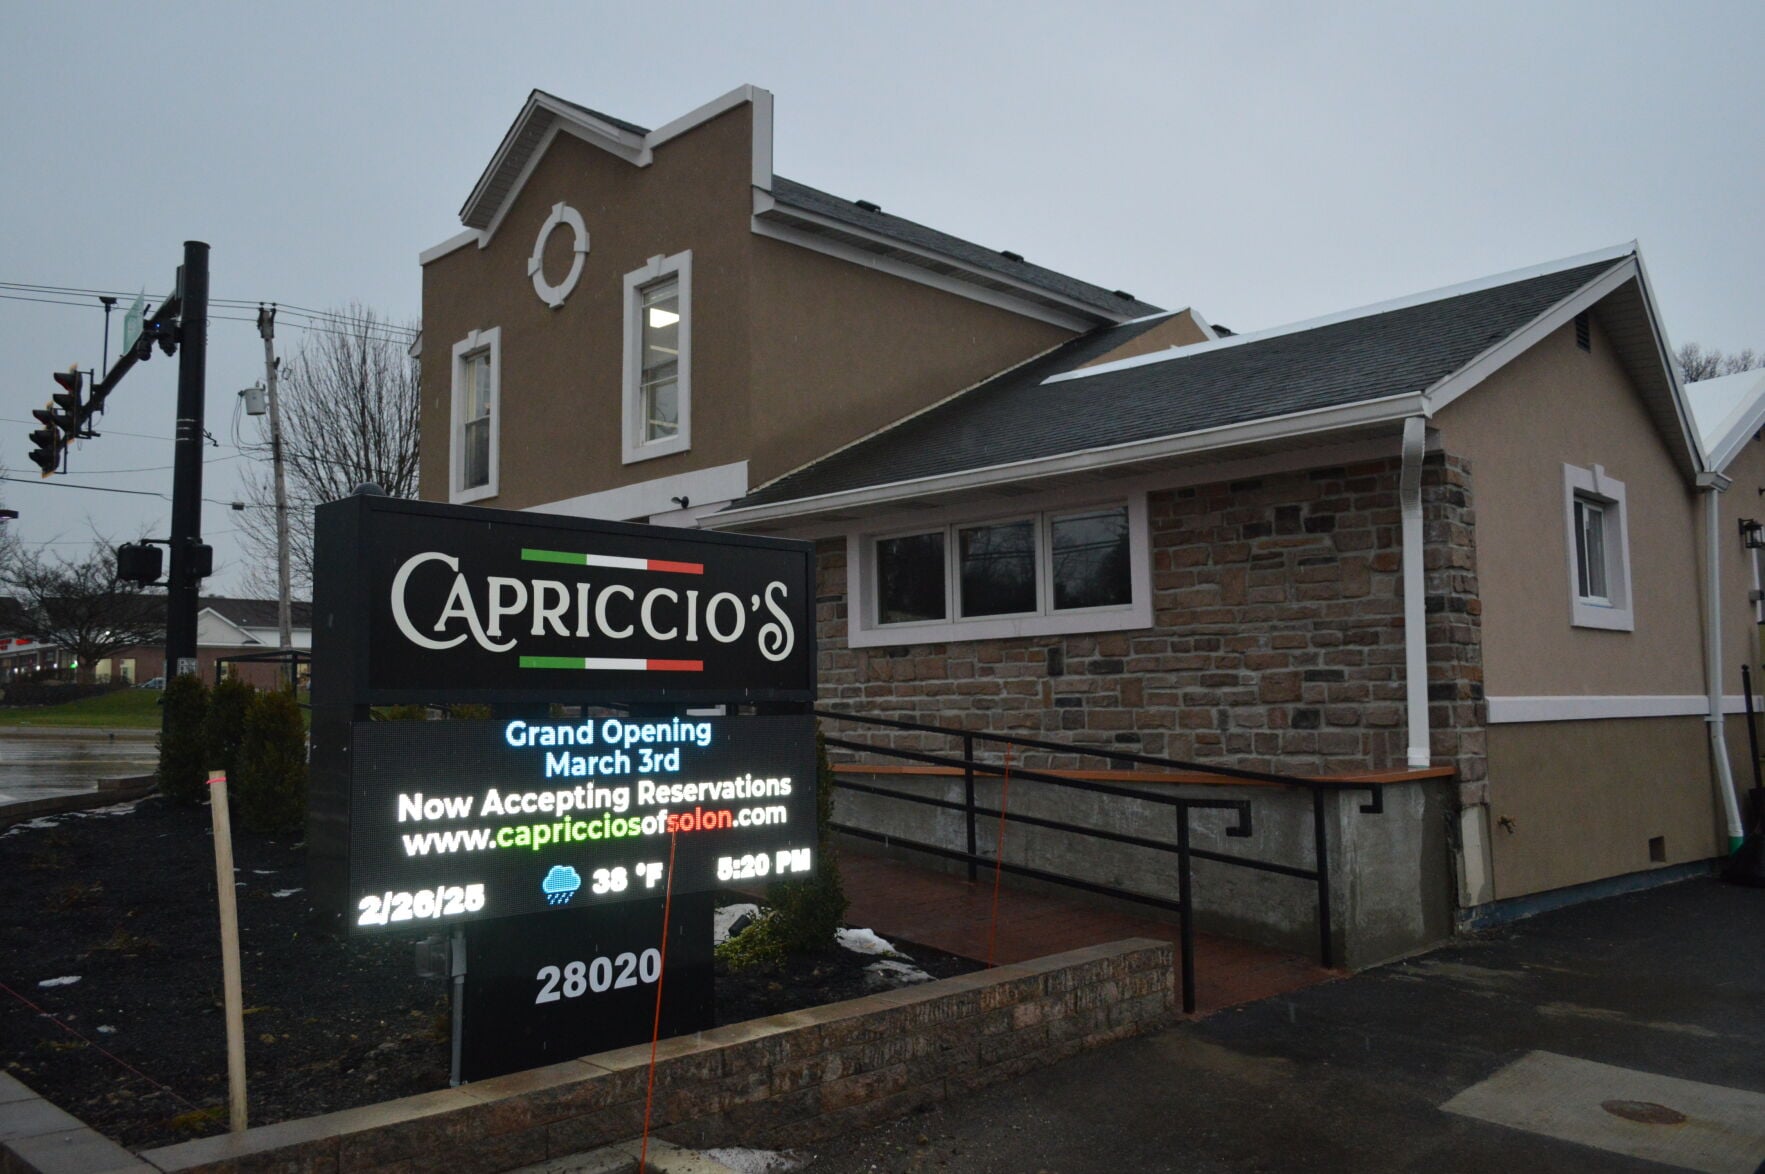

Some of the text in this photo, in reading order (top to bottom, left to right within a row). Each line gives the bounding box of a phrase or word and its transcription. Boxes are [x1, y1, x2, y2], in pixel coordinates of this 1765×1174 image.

[391, 551, 795, 663] CAPRICCIO'S
[505, 717, 712, 749] Grand Opening
[545, 748, 680, 778] March 3rd
[398, 774, 792, 823] Now Accepting Reservations
[402, 805, 787, 857] www.capricciosofsolon.com
[776, 848, 811, 874] PM
[535, 948, 662, 1004] 28020
